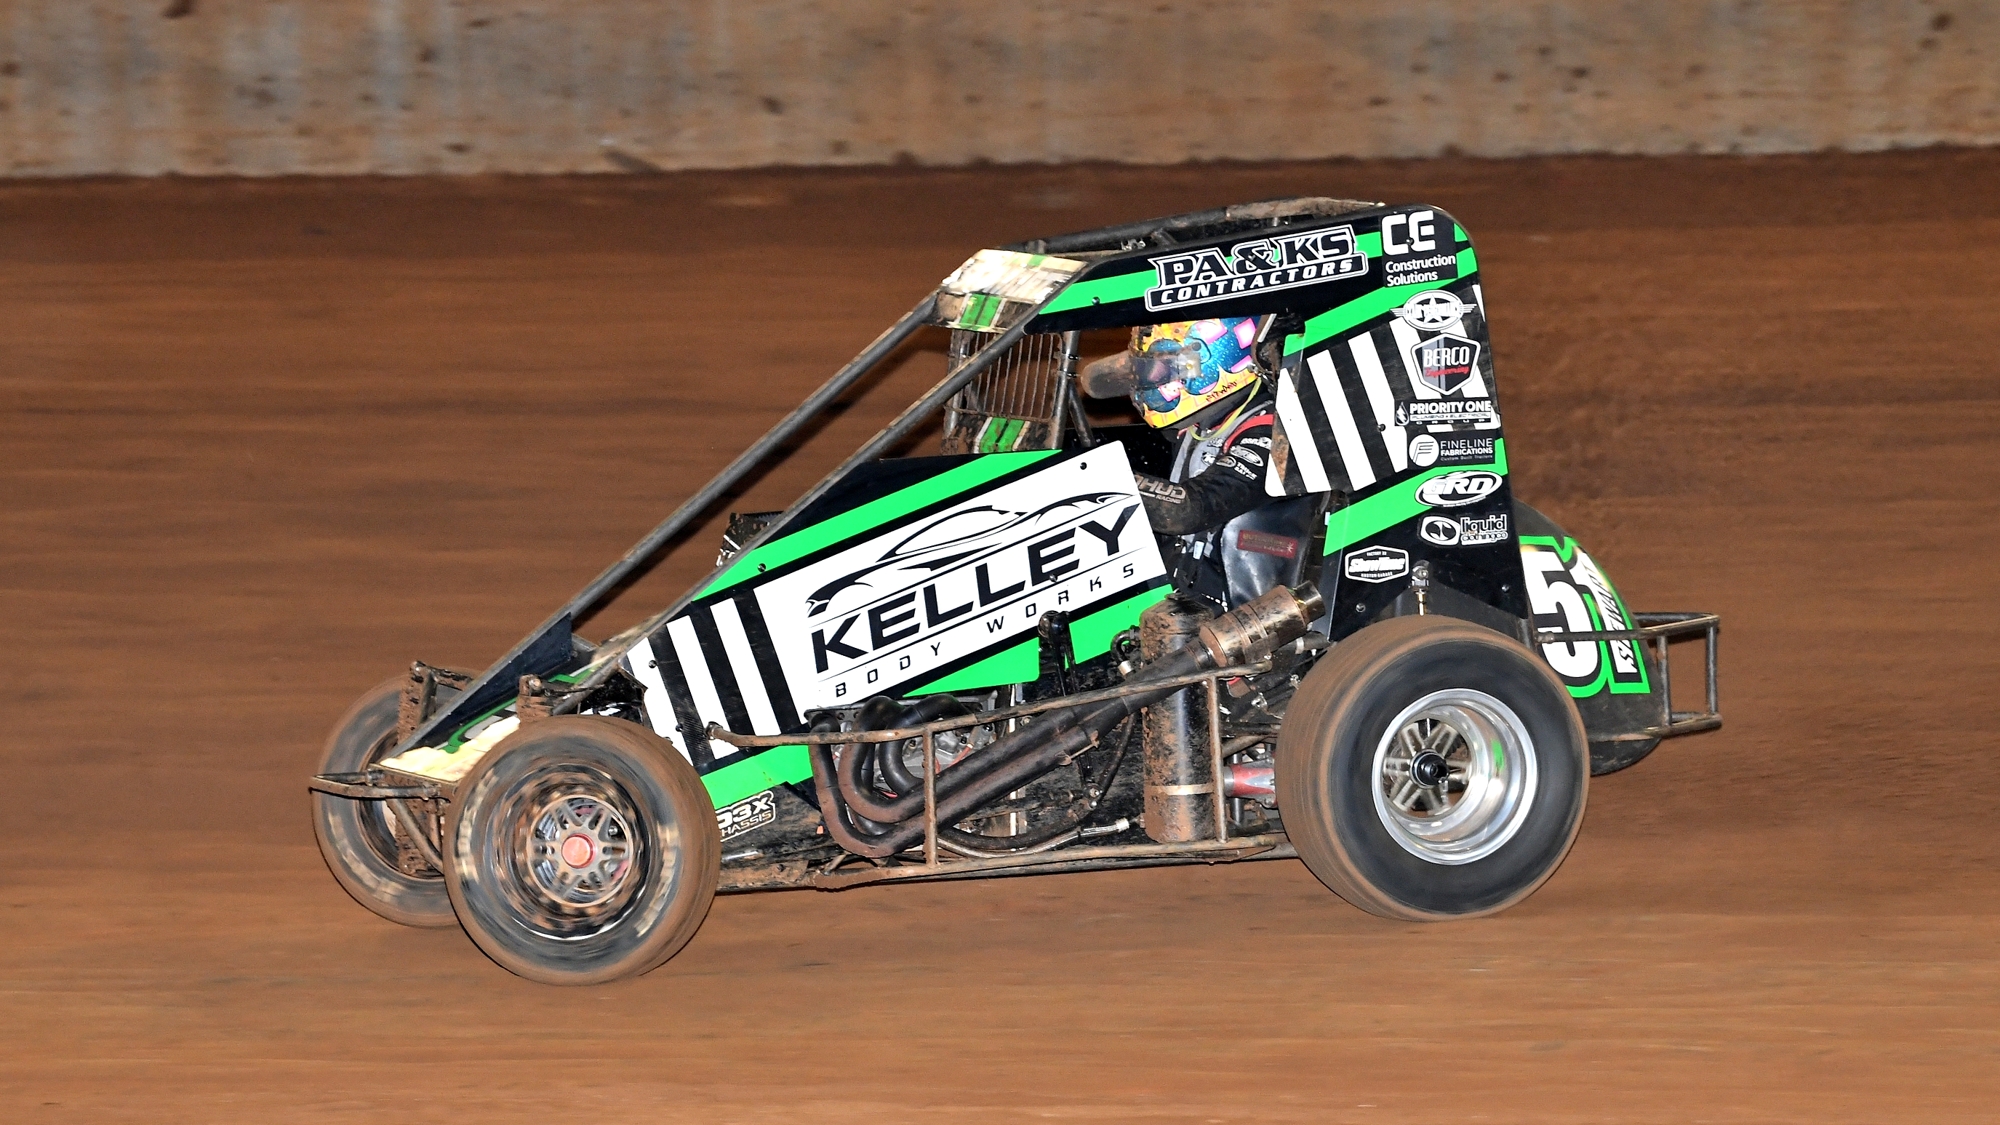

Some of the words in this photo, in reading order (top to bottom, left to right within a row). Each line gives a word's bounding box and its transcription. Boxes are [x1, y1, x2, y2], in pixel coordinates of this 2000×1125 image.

[1157, 228, 1355, 288] PA&KS
[1385, 254, 1457, 273] Construction
[1161, 259, 1353, 304] CONTRACTORS
[1386, 270, 1439, 287] Solutions
[1423, 346, 1470, 367] BERCO
[1409, 401, 1465, 414] PRIORITY
[1465, 400, 1492, 412] ONE
[1440, 438, 1493, 449] FINELINE
[1440, 447, 1494, 457] FABRICATIONS
[1423, 478, 1494, 495] GRD
[1461, 514, 1507, 534] liquid
[811, 503, 1141, 674] KELLEY
[835, 642, 941, 698] BODY
[987, 563, 1134, 634] WORKS
[720, 810, 772, 837] HASSIS
